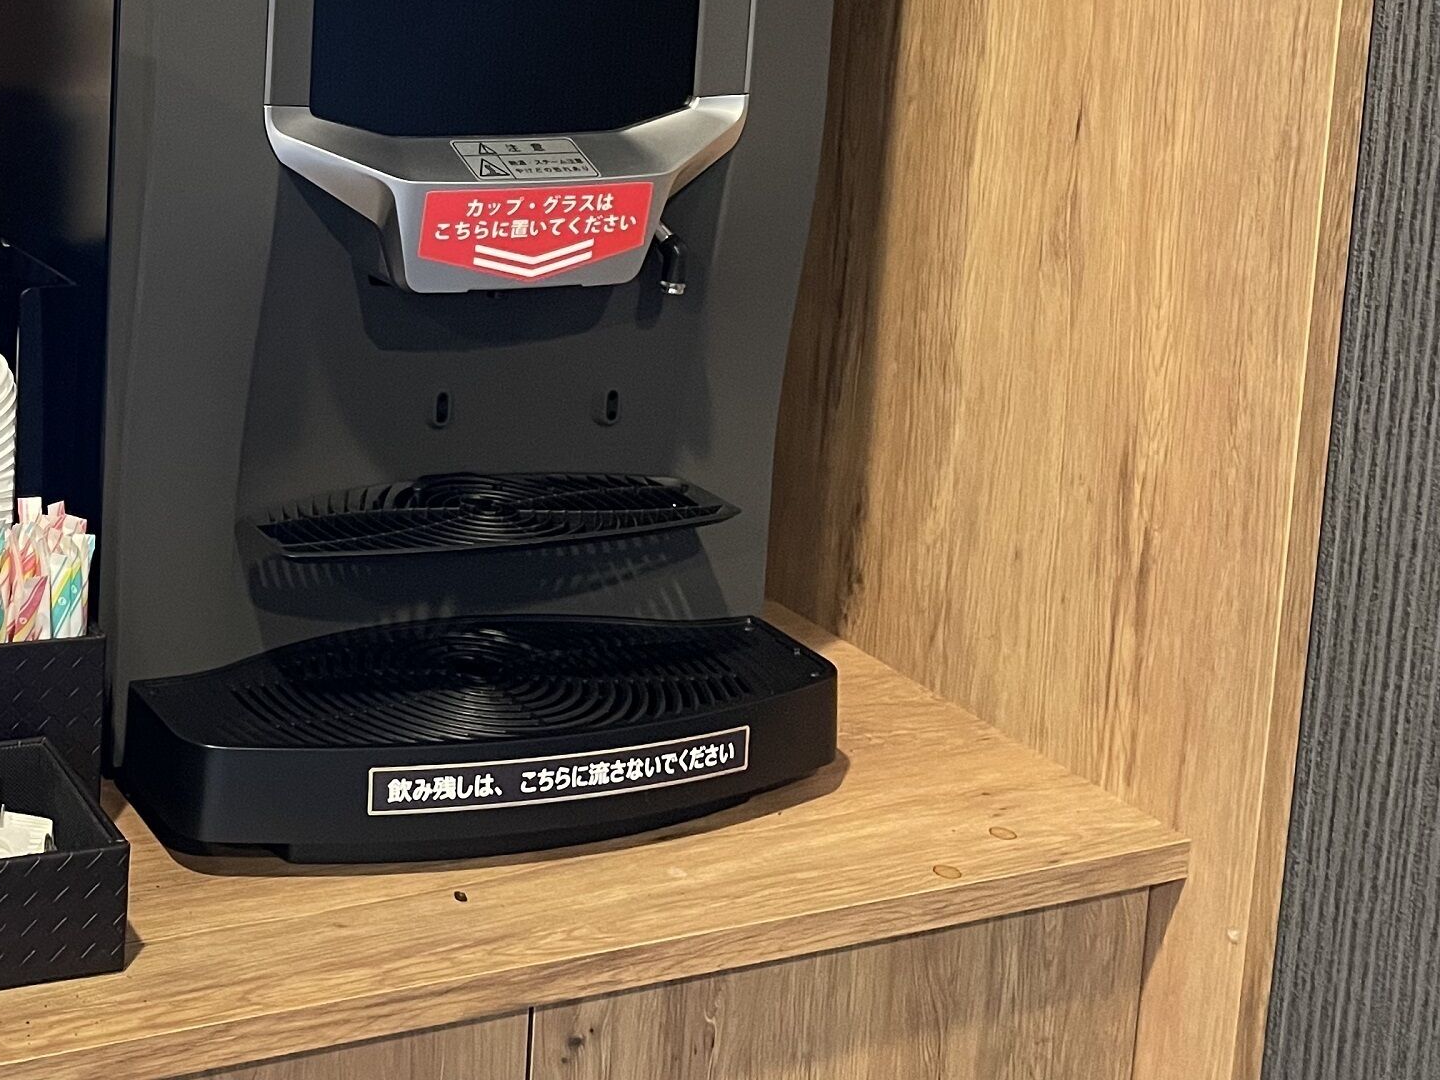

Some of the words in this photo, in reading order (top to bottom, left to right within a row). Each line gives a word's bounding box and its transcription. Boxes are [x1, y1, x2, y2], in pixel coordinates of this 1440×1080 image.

[467, 193, 615, 218] カップ・グラスは
[434, 216, 638, 241] こちらに置いてください
